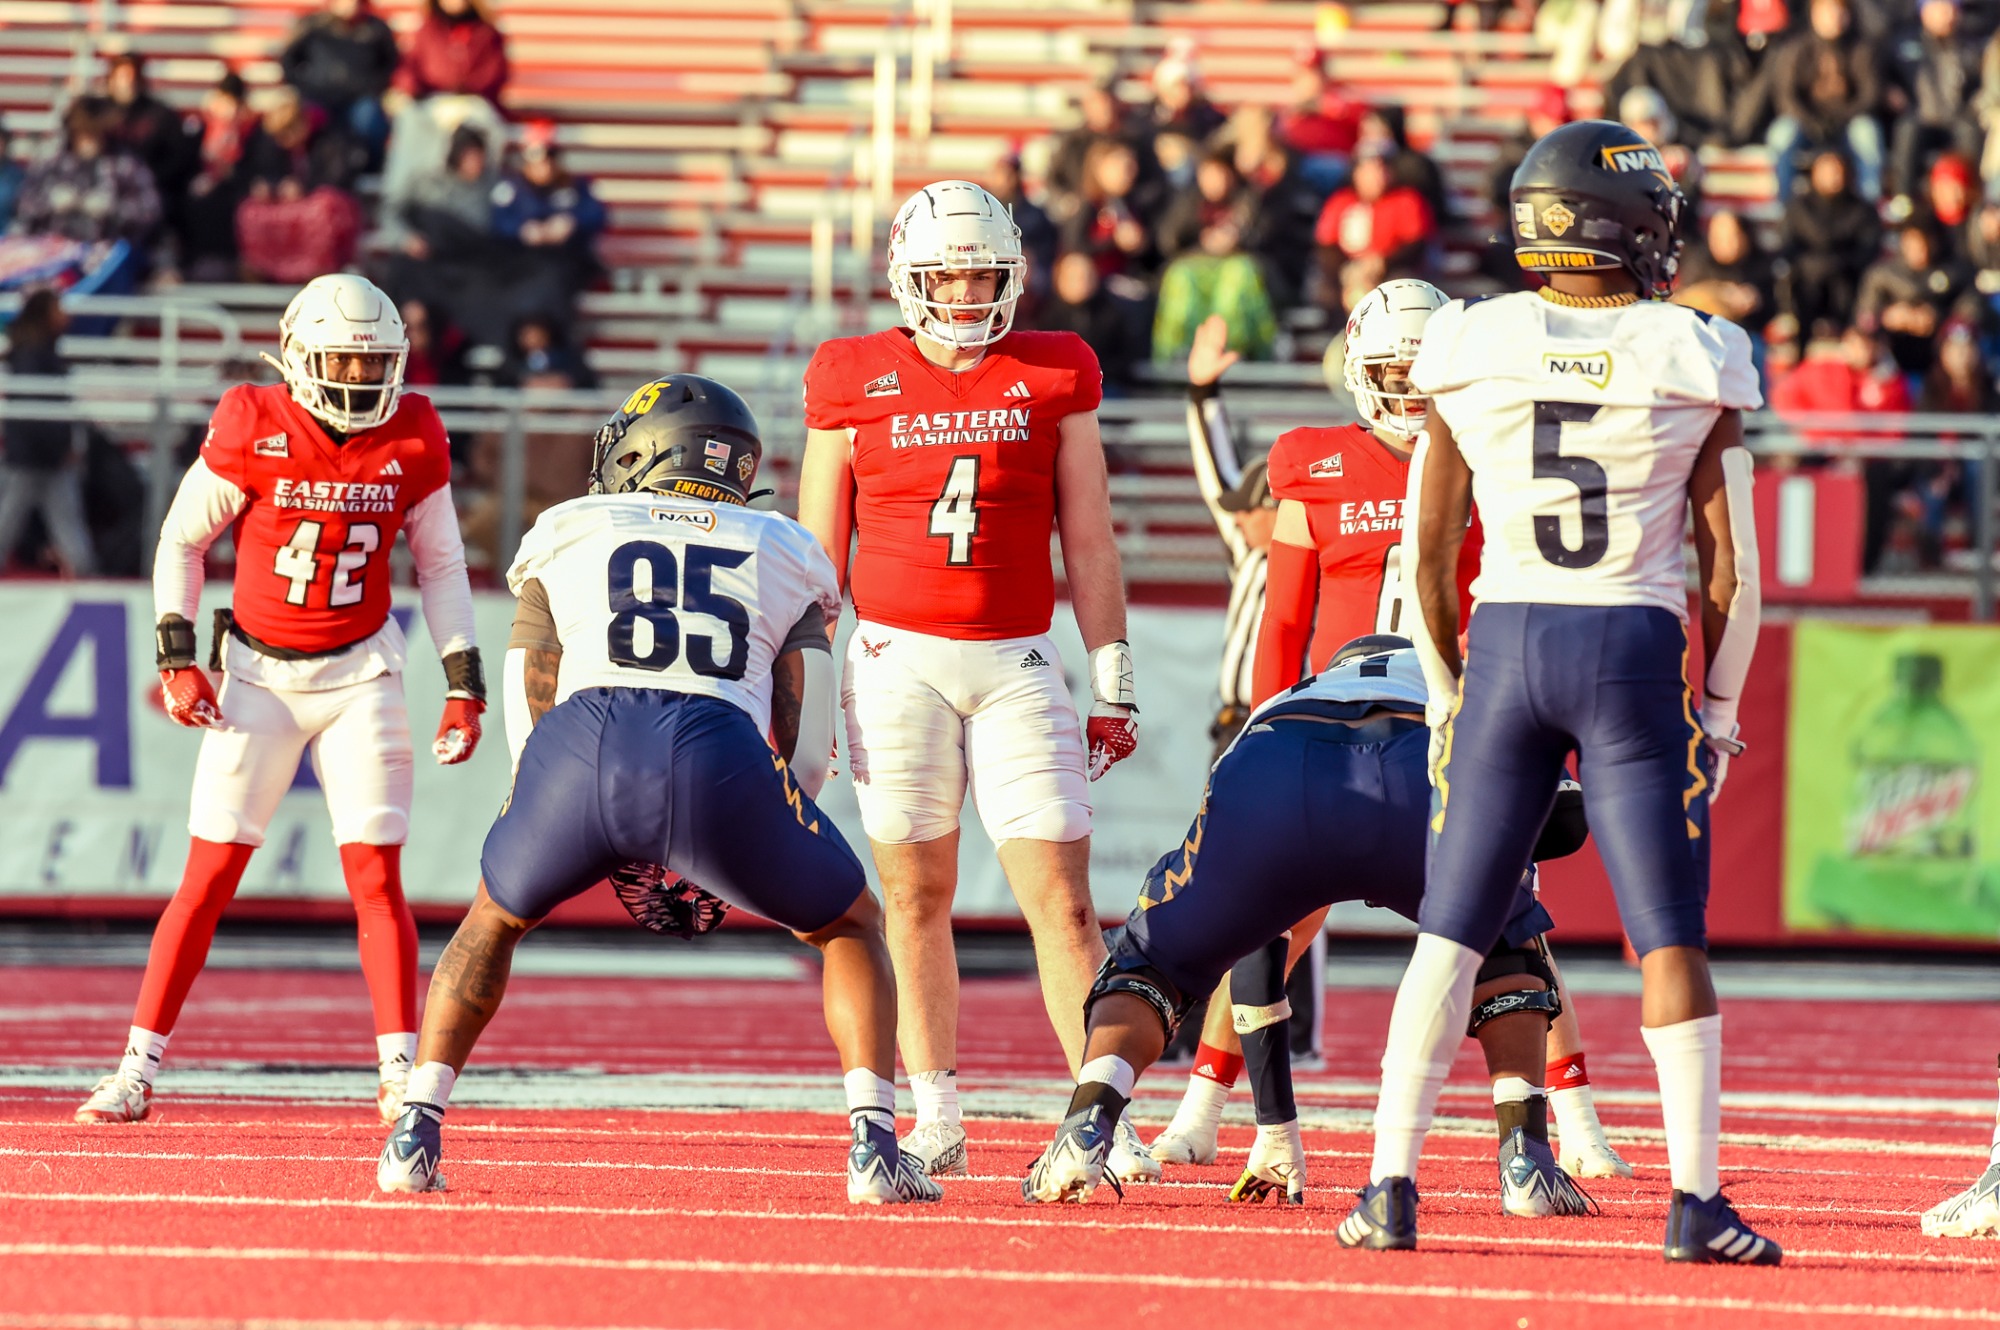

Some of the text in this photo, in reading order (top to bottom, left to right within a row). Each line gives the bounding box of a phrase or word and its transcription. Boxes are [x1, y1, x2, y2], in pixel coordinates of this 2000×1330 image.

[1550, 359, 1604, 376] NAU
[890, 408, 1031, 435] EASTERN
[890, 428, 1031, 449] WASHINGTON
[275, 478, 400, 500] EASTERN
[674, 480, 720, 500] ENERGY
[1533, 400, 1609, 569] 5
[273, 494, 396, 512] WASHINGTON
[927, 455, 981, 566] 4
[1340, 498, 1408, 521] EAST
[658, 512, 709, 525] NAU
[273, 518, 381, 608] 42
[607, 540, 755, 680] 85
[1020, 660, 1050, 668] adidas
